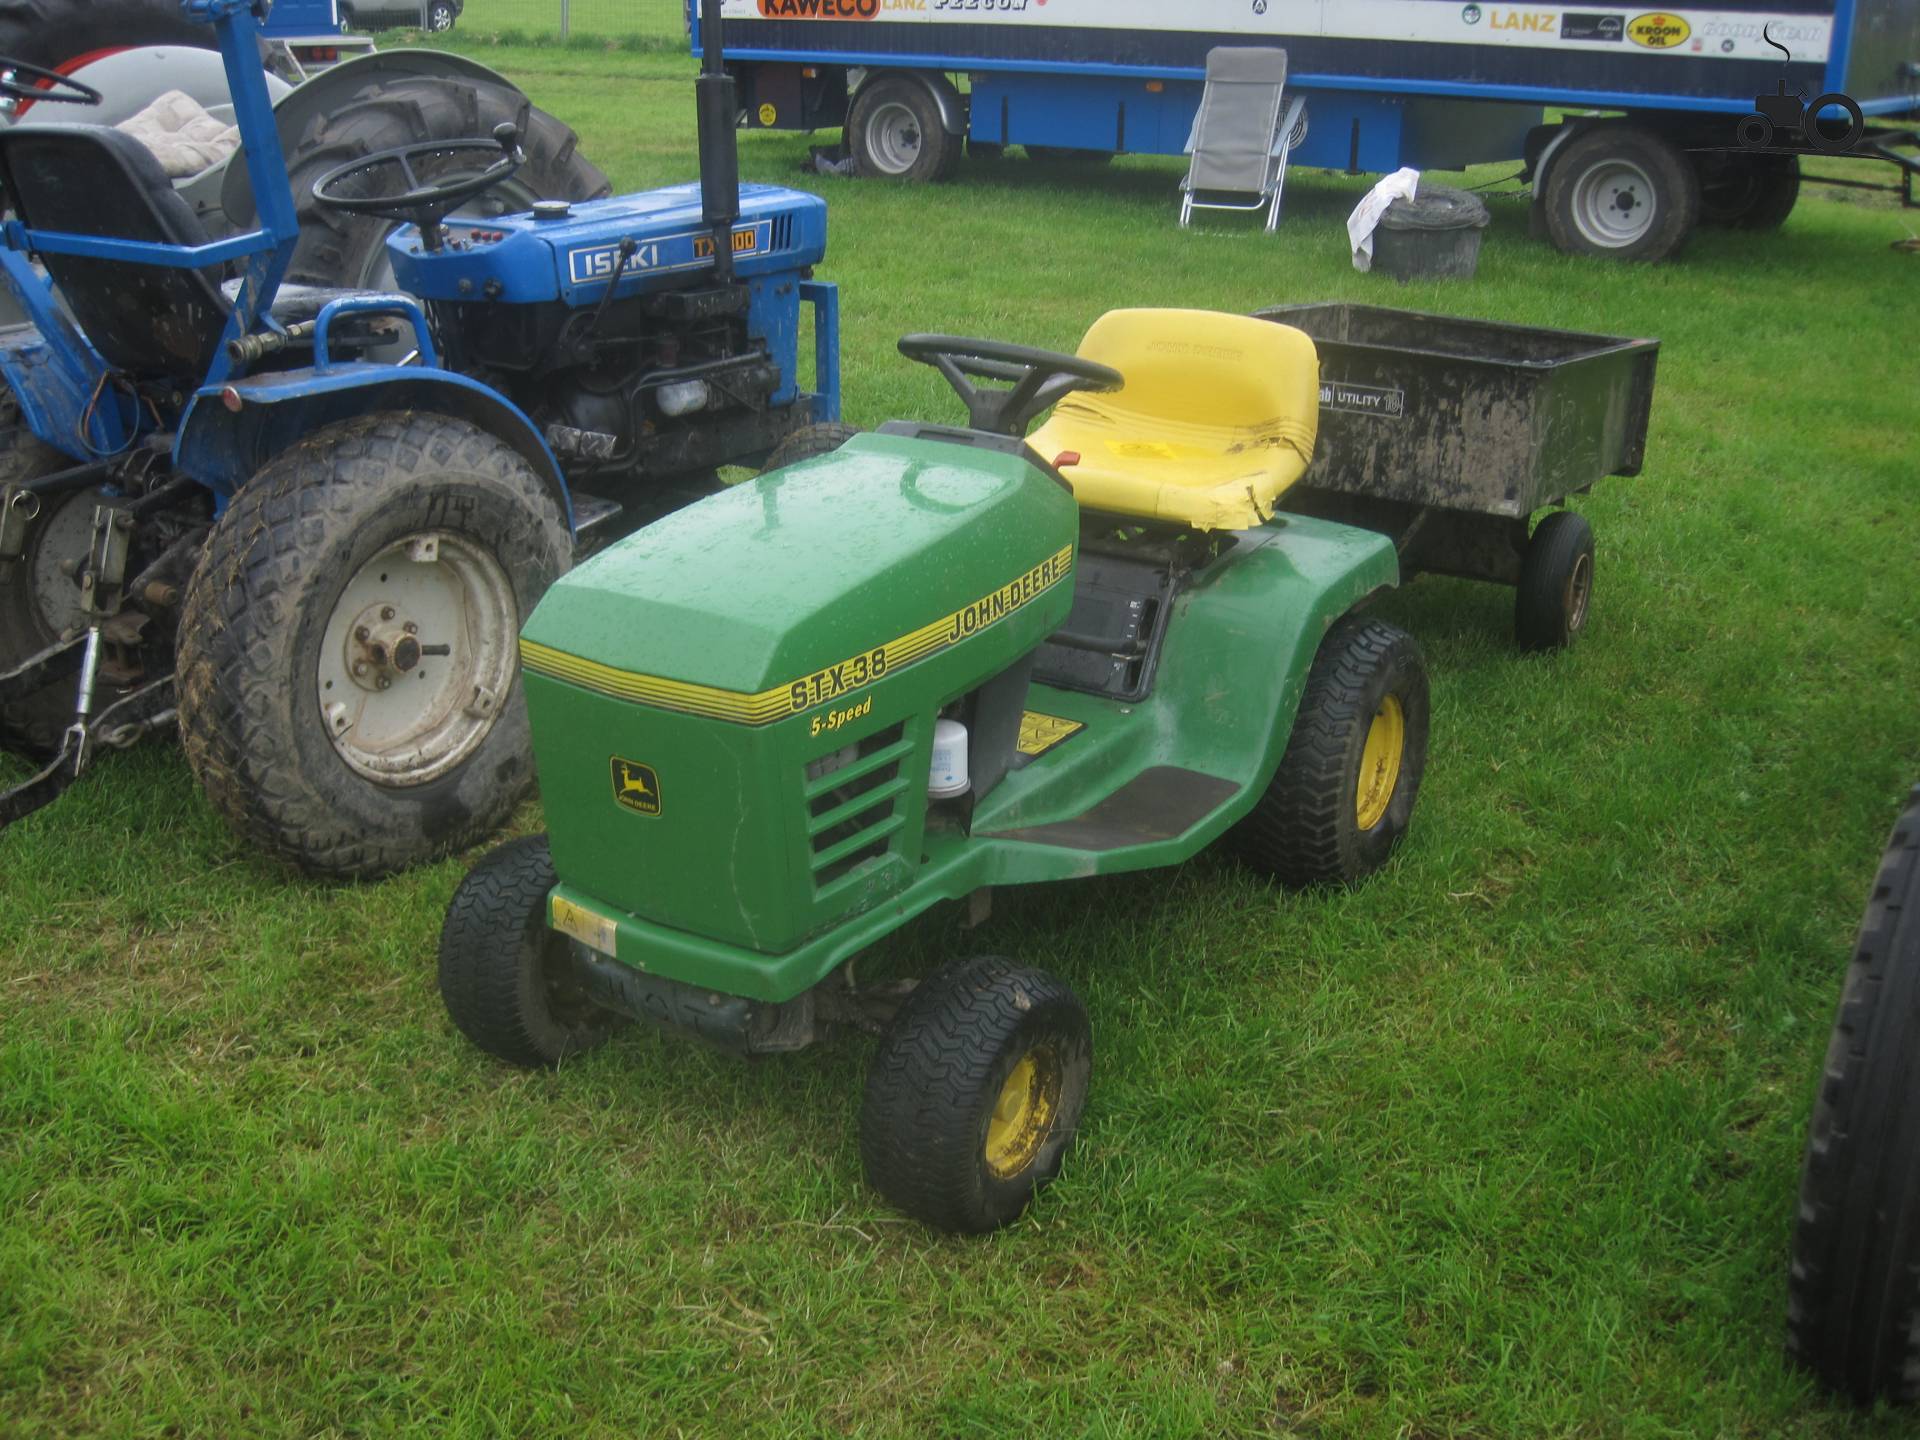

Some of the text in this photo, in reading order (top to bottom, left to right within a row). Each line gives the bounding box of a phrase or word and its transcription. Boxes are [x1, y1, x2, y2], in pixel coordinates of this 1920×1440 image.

[764, 0, 874, 16] KAWECO
[1489, 11, 1557, 32] LANZ
[1636, 25, 1681, 36] KROON
[1647, 36, 1667, 45] OIL
[1337, 391, 1381, 407] UTILITY
[949, 555, 1061, 643] JOHN DEERE
[790, 648, 888, 712] STX 38
[809, 694, 873, 737] 5-Speed
